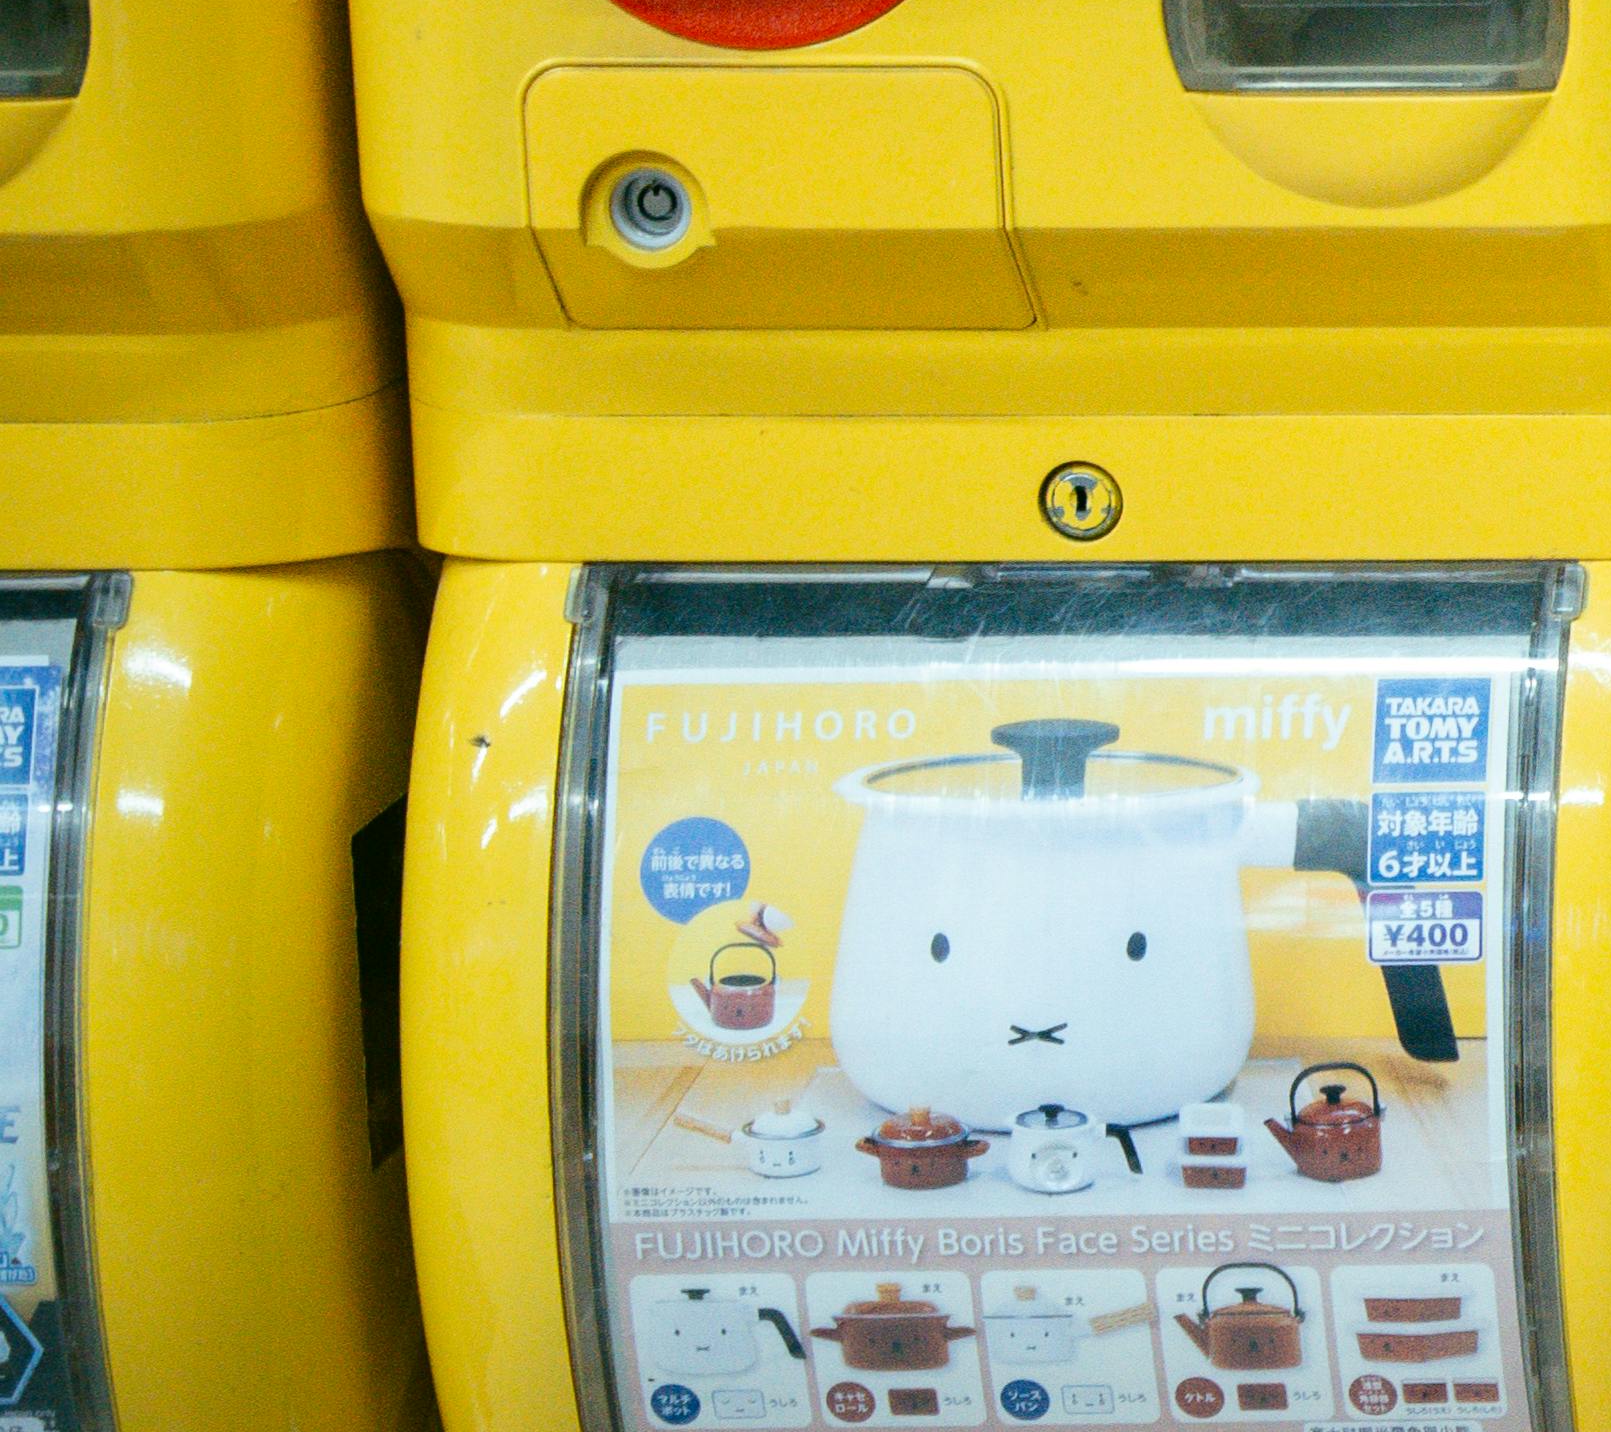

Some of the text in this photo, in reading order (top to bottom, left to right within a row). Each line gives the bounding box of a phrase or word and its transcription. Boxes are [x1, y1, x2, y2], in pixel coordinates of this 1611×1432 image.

[1385, 694, 1481, 716] TAKARA
[645, 707, 918, 744] FUJIHORO
[1202, 692, 1352, 751] miffy
[1386, 716, 1480, 740] TOMY
[1376, 810, 1479, 837] 対象年齢
[1377, 851, 1478, 879] 6才以上
[634, 1219, 1487, 1264] FUJIHORO Miffy Boris Face Series ミニコレクション
